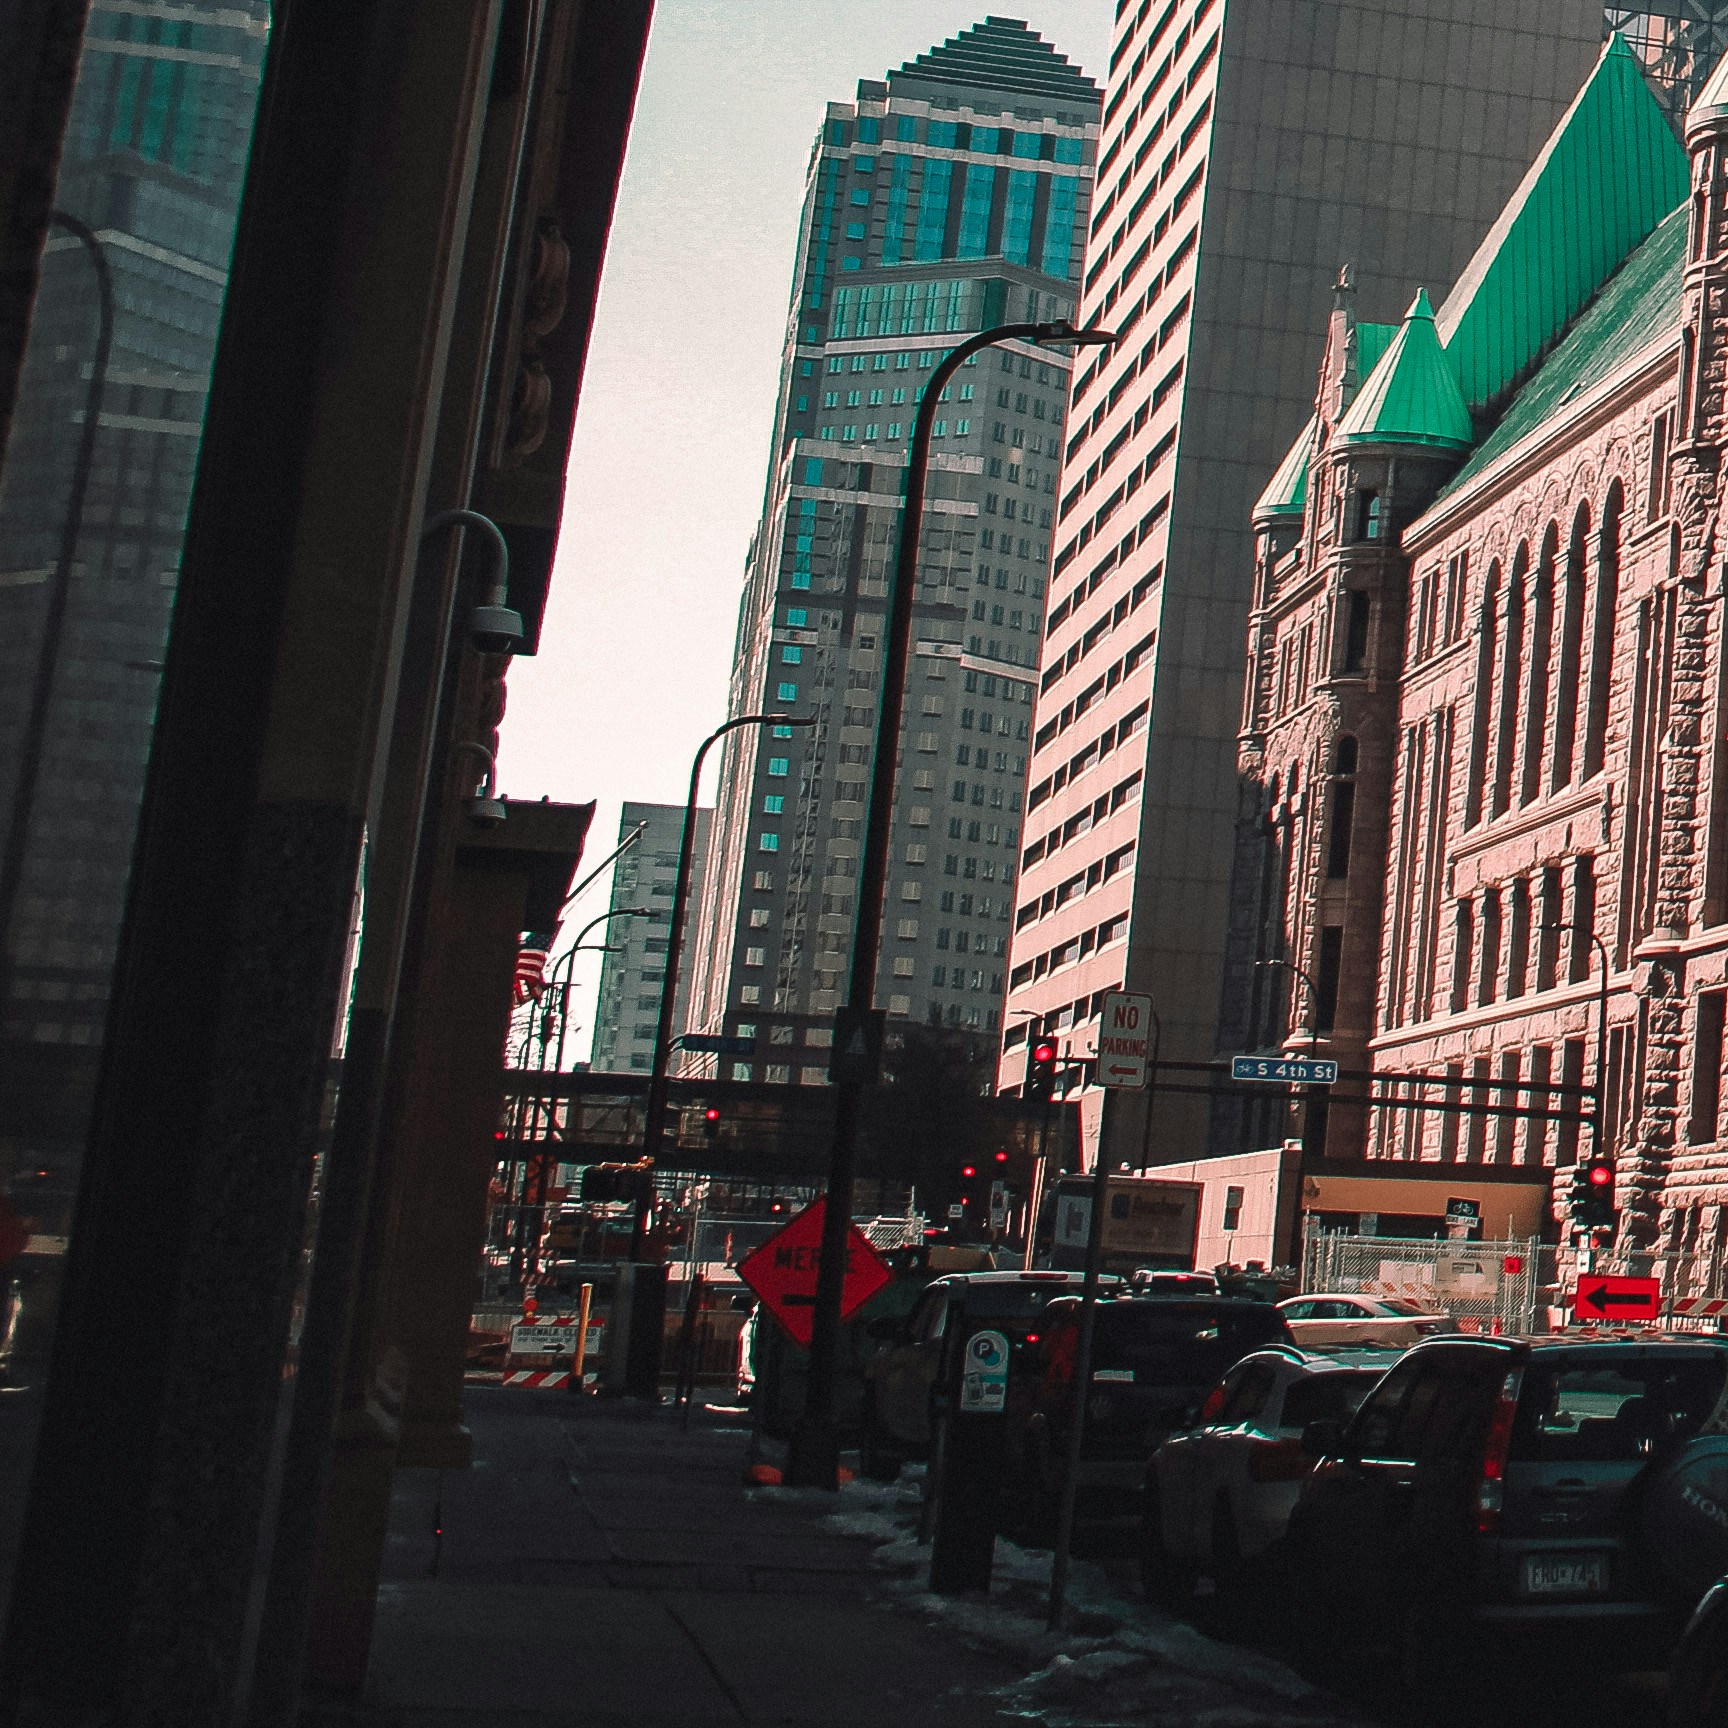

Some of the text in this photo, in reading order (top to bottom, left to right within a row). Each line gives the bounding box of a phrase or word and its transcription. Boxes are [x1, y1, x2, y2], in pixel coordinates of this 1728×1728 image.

[1114, 1005, 1139, 1030] NO
[1101, 1036, 1147, 1058] PARKING
[1257, 1062, 1333, 1079] S 4th St
[774, 1246, 857, 1273] MERE
[979, 1342, 990, 1355] P
